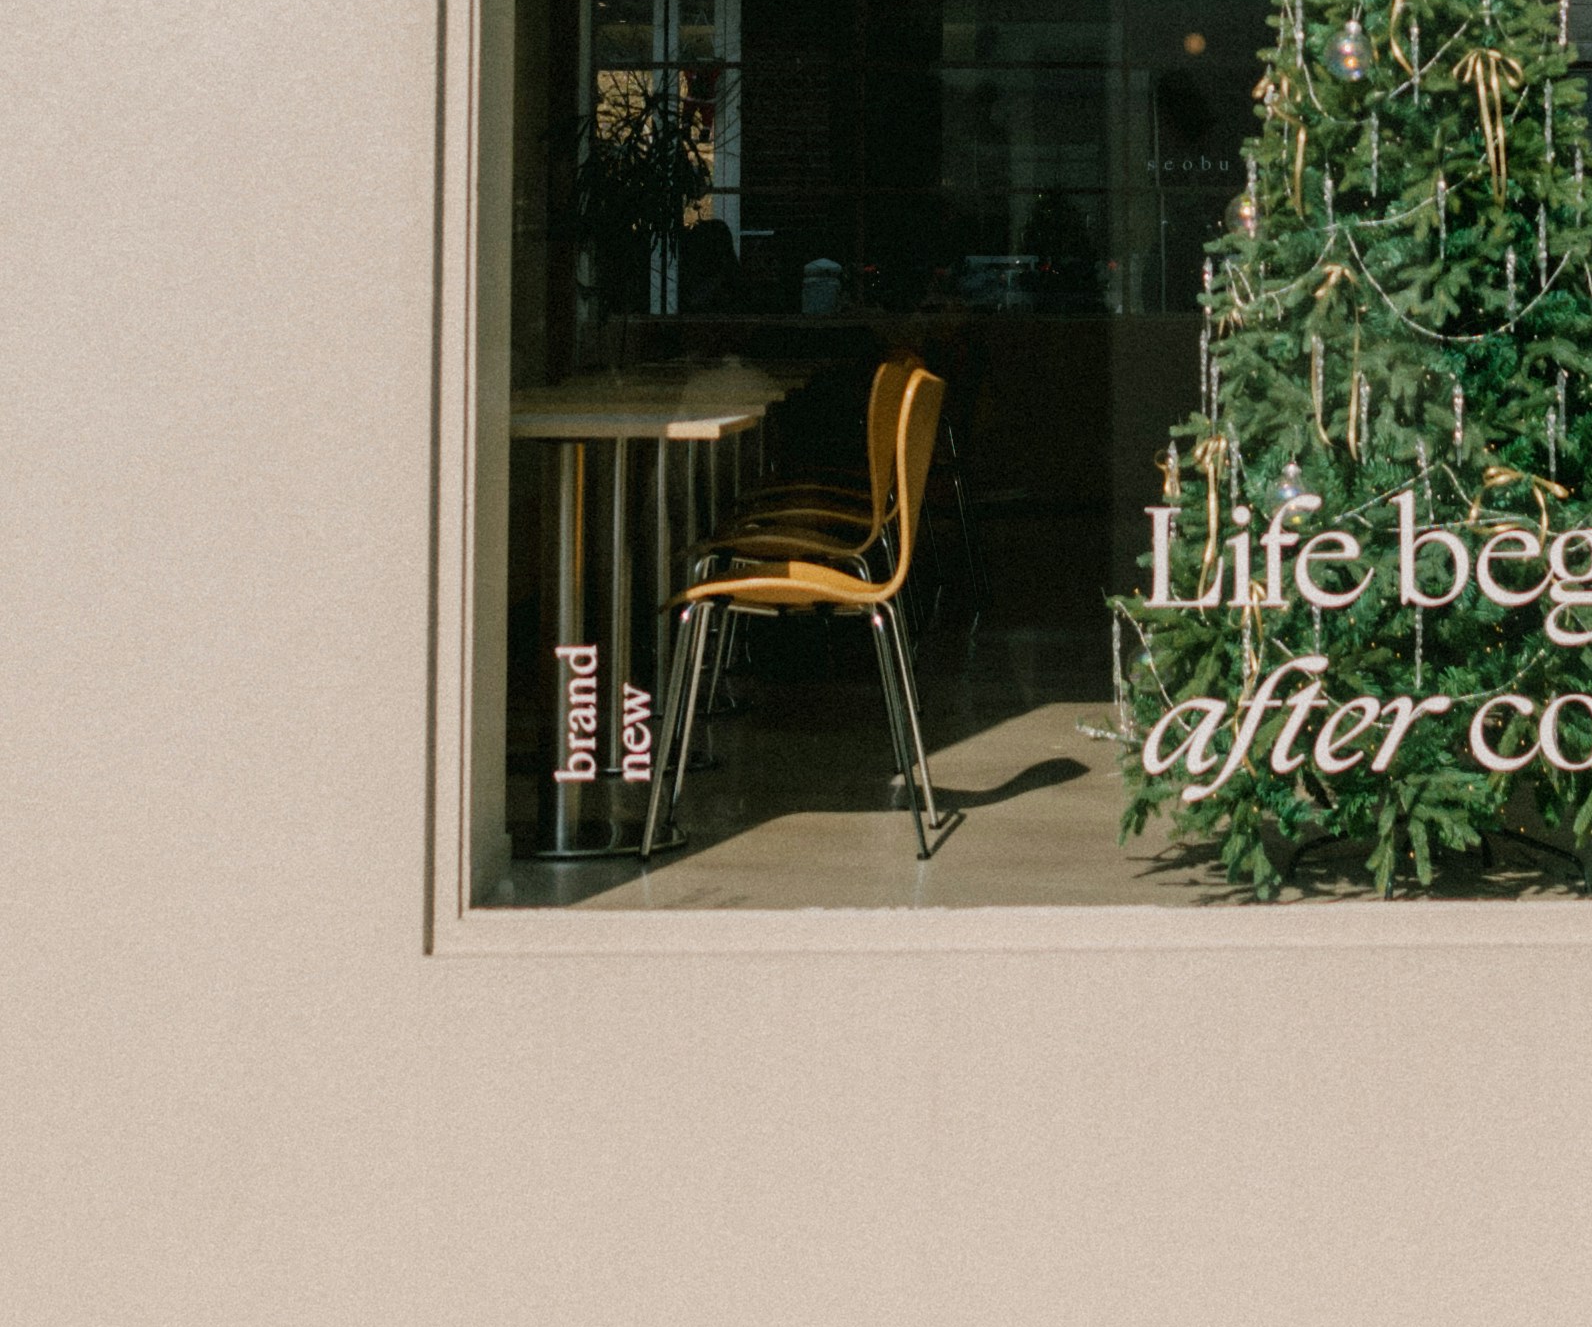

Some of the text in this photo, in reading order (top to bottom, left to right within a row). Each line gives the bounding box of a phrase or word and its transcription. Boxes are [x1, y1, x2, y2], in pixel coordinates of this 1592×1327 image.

[1147, 155, 1230, 171] seobu
[1143, 494, 1374, 608] Life
[554, 644, 598, 782] brand
[623, 682, 651, 781] new
[1142, 655, 1451, 803] after
